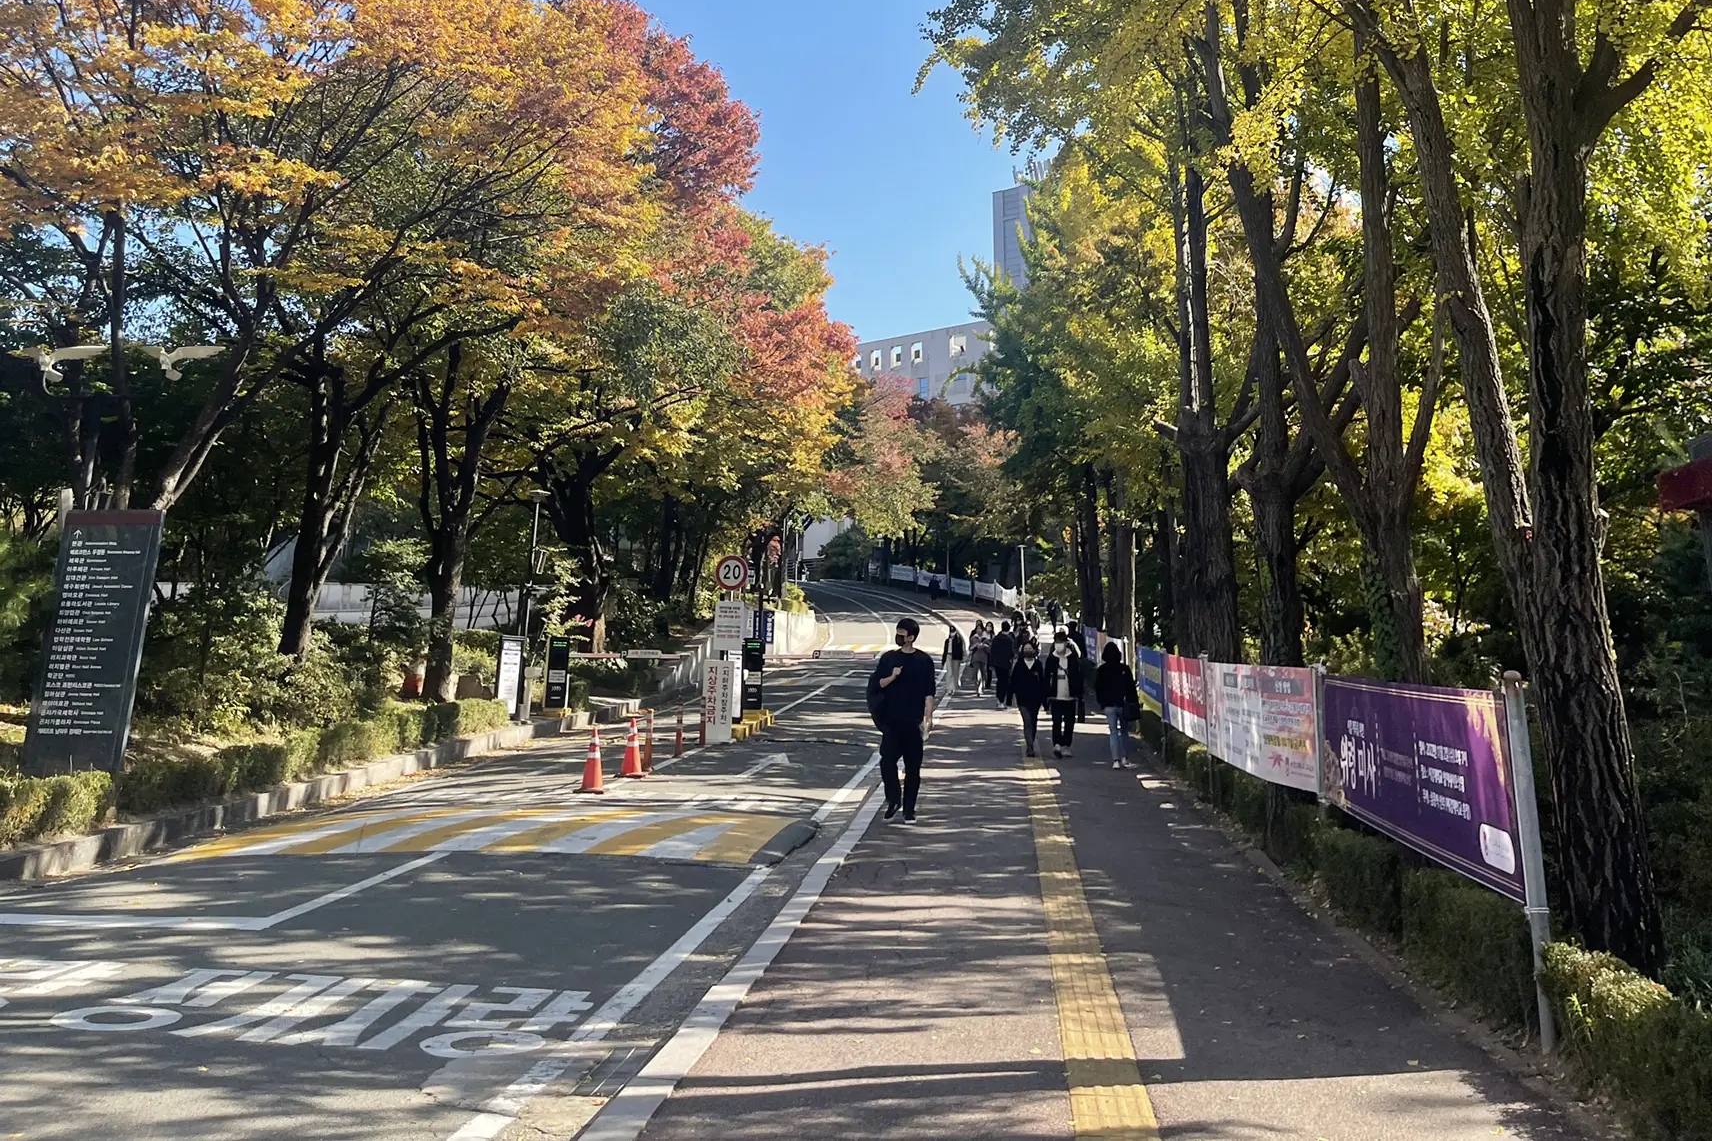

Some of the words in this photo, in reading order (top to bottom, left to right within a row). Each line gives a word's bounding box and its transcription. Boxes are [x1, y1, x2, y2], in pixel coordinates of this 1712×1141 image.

[723, 564, 741, 580] 20
[706, 666, 718, 725] 지상주차금지
[1339, 734, 1357, 790] 위령
[1357, 740, 1377, 800] 미사
